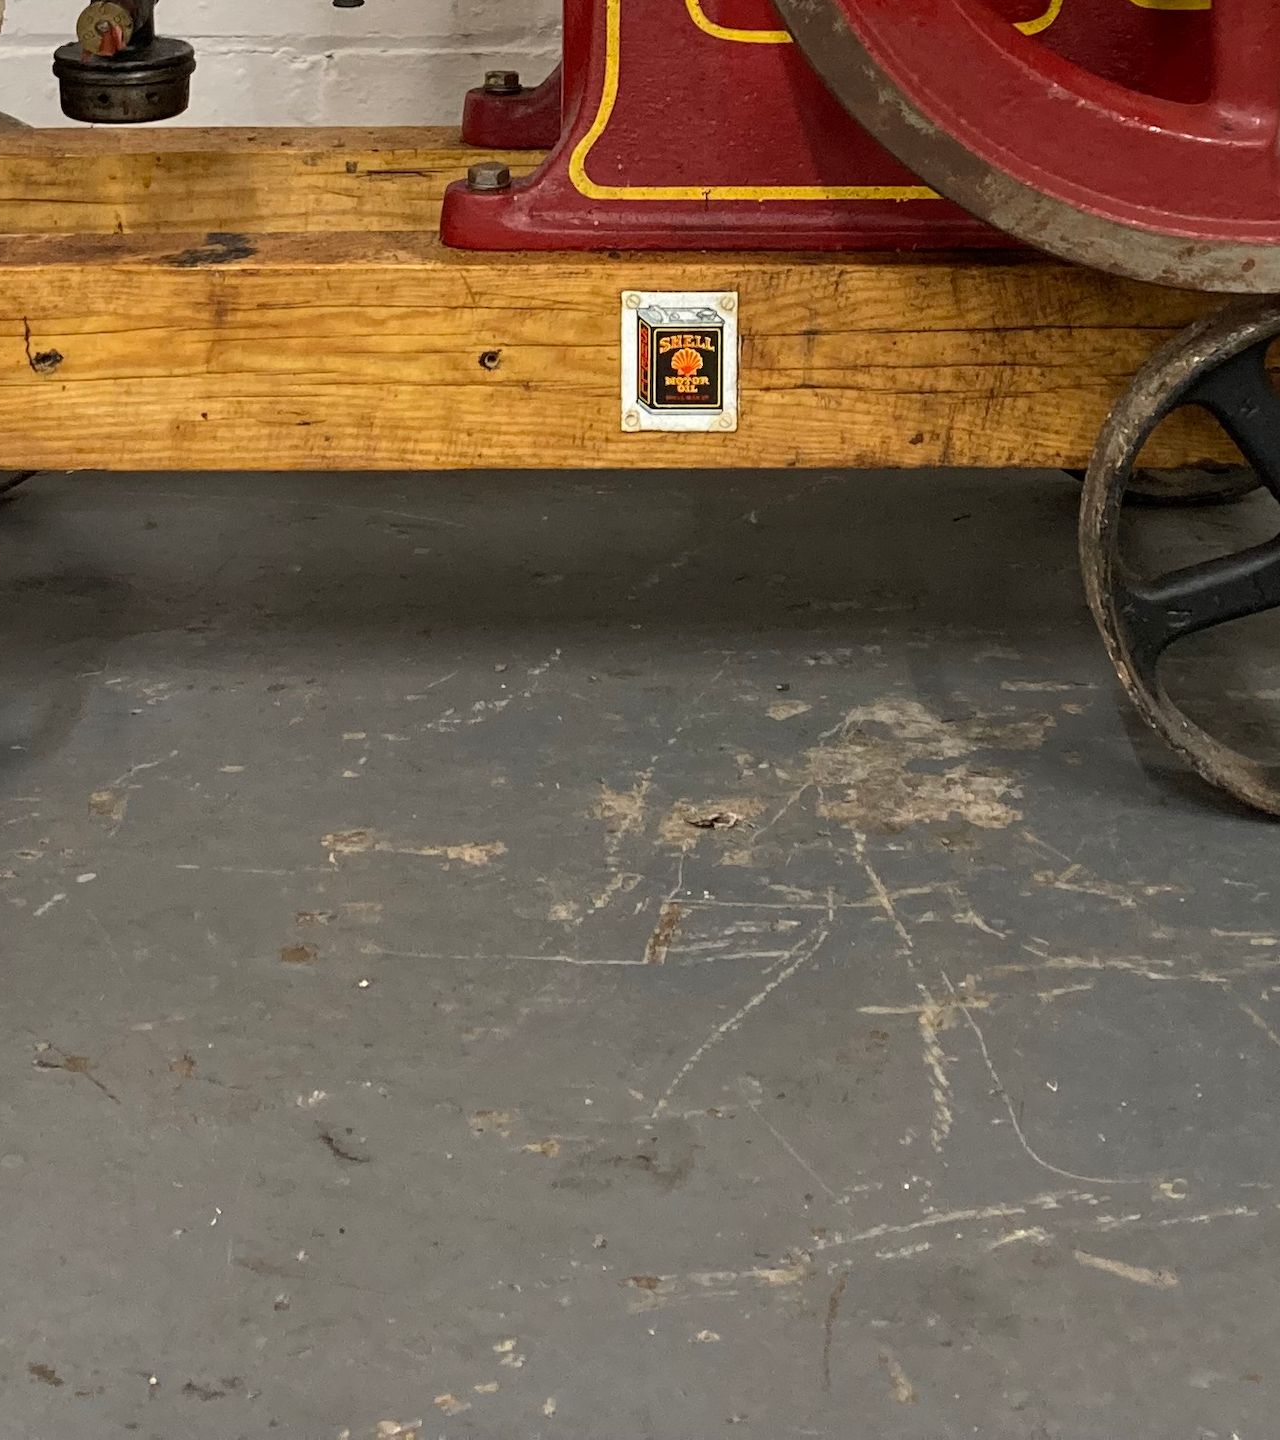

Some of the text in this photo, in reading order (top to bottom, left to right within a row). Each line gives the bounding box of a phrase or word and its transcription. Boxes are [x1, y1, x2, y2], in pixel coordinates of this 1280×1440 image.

[660, 334, 715, 354] SHELL
[665, 376, 710, 386] MOTOR
[677, 385, 698, 393] OIL
